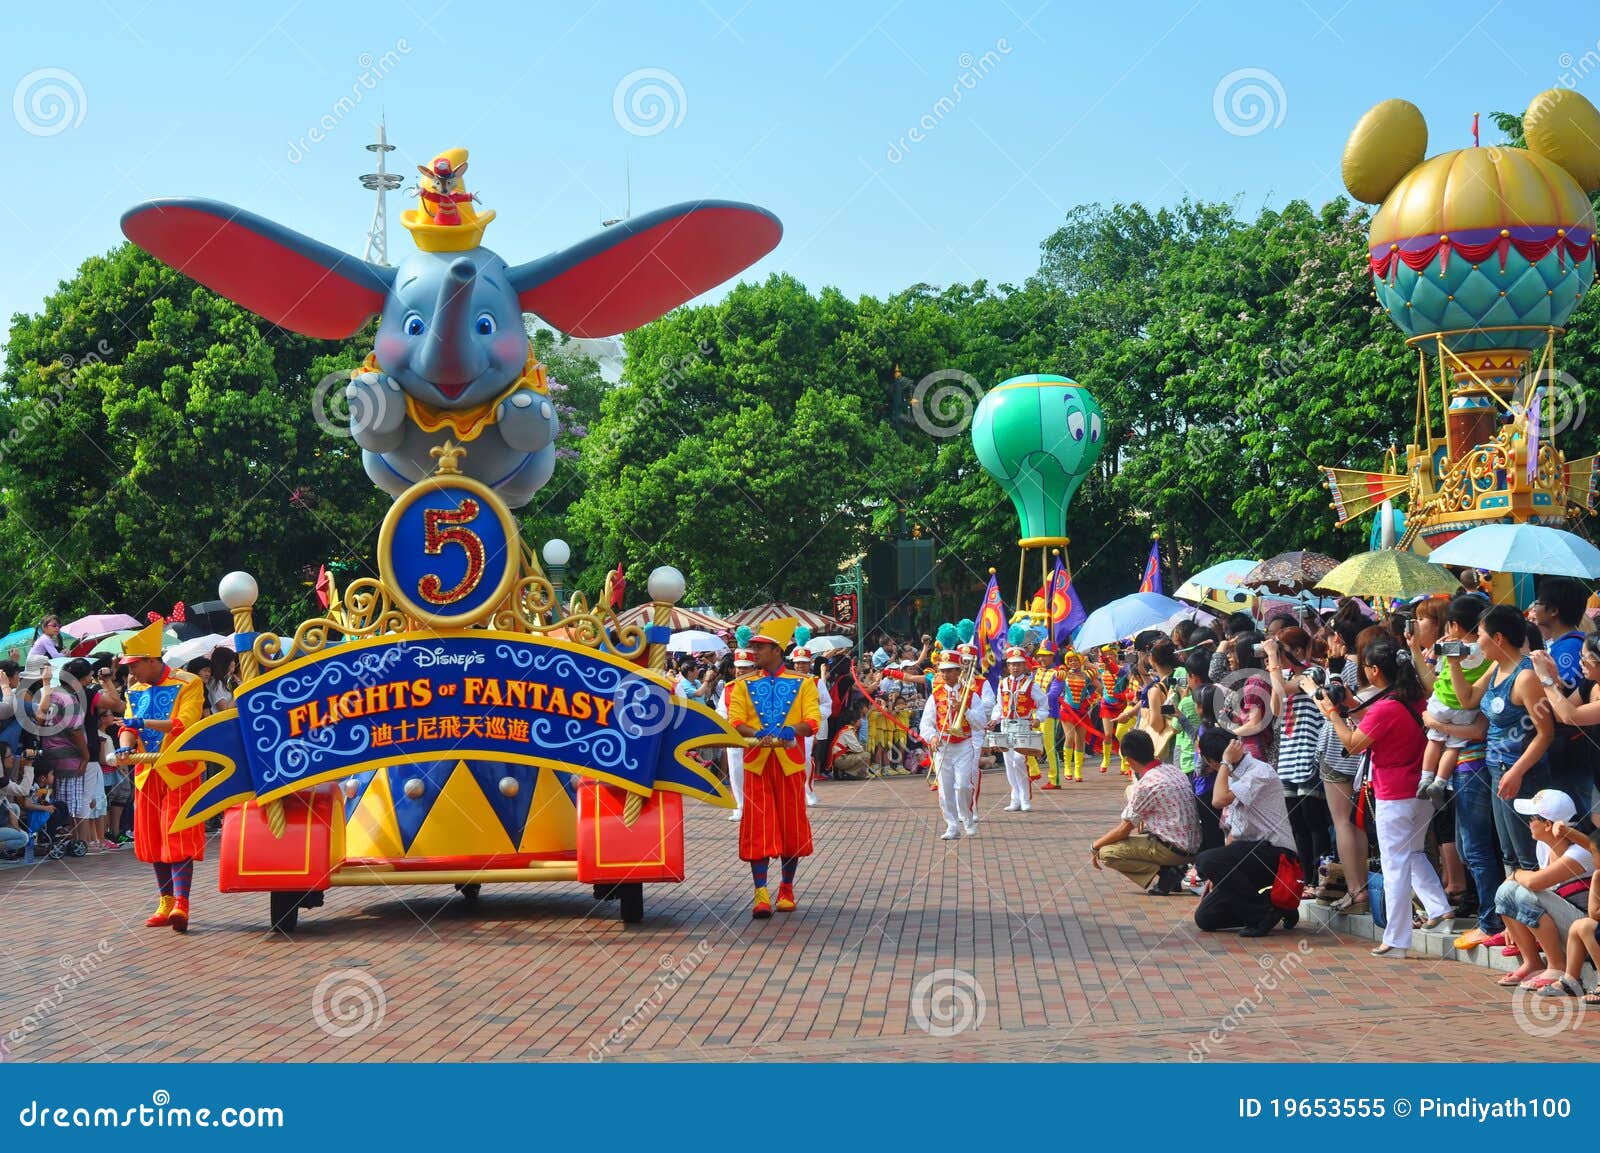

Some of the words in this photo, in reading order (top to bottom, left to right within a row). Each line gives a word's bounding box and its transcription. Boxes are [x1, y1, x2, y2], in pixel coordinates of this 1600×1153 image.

[418, 498, 485, 605] 5
[287, 677, 434, 737] FLIGHTS
[437, 683, 458, 698] OF
[462, 677, 616, 727] FANTASY
[370, 715, 531, 749] 迪士尼飛天巡遊
